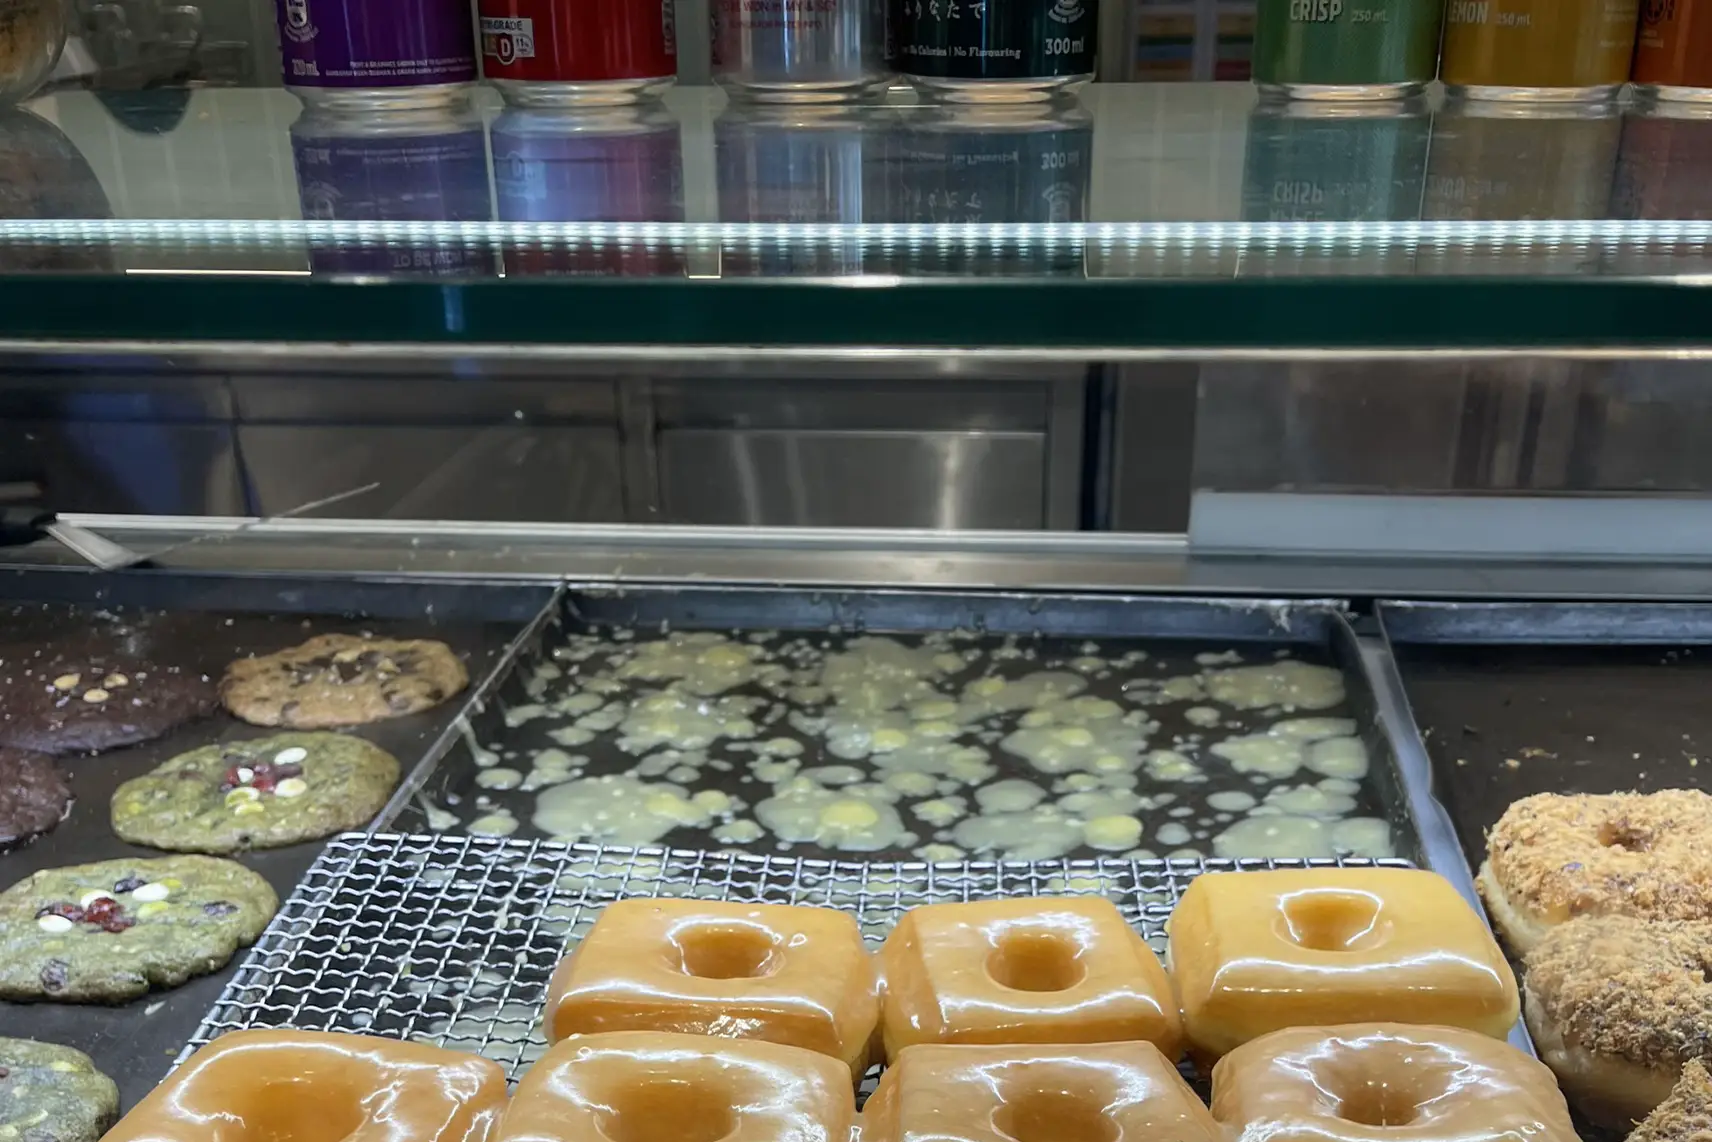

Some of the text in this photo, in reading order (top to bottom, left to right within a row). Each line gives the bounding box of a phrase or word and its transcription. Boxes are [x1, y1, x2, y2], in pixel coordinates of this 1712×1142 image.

[1290, 0, 1342, 22] CRISP
[954, 46, 967, 57] No
[1045, 37, 1070, 55] 300
